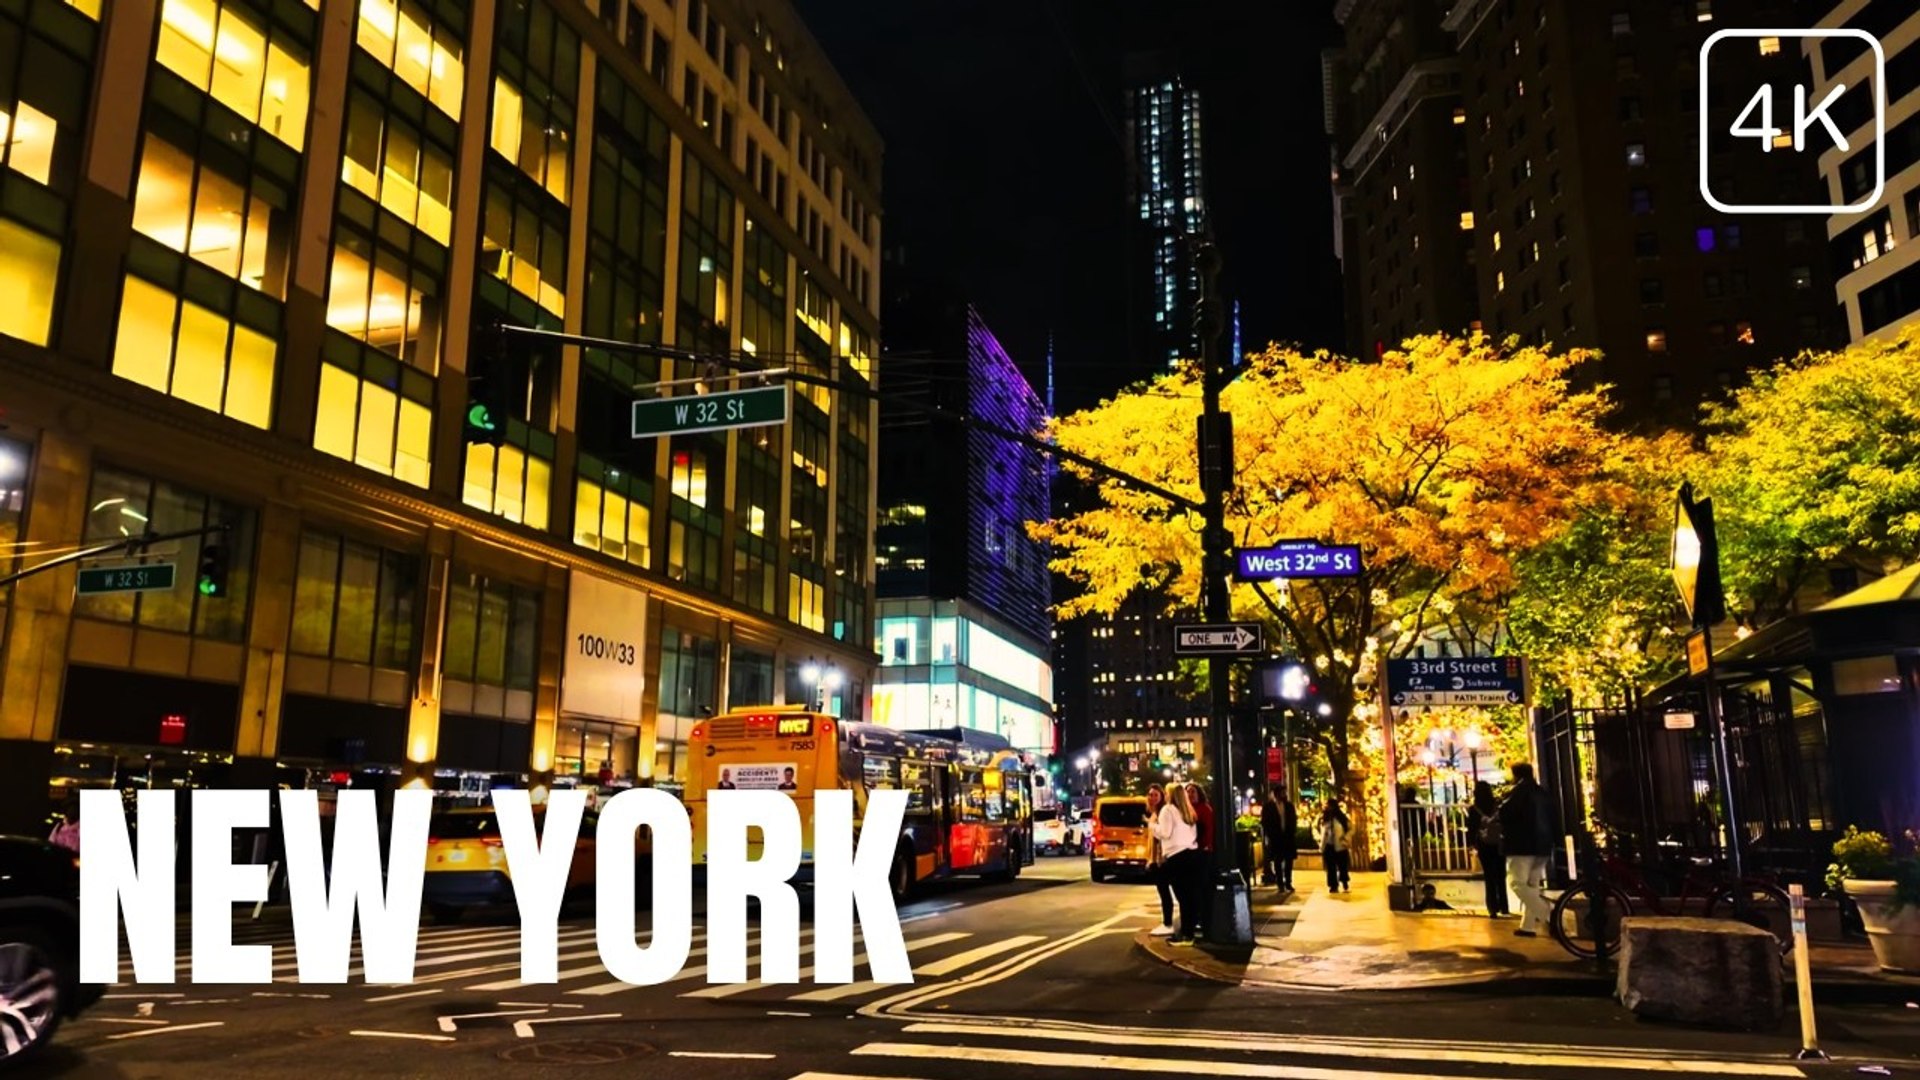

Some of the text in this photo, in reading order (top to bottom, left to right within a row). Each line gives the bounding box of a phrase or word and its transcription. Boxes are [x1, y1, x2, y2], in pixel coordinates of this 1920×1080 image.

[674, 399, 745, 425] W 32 St
[1246, 553, 1352, 572] West 32nd St
[104, 571, 149, 588] W 32 St
[1188, 631, 1248, 645] ONE WAY
[577, 633, 635, 666] 100W33
[1410, 660, 1498, 675] 33rd Street
[1466, 679, 1502, 688] Subway
[1454, 693, 1506, 702] PATH Trains
[778, 718, 810, 734] NYCT
[790, 741, 815, 751] 7583
